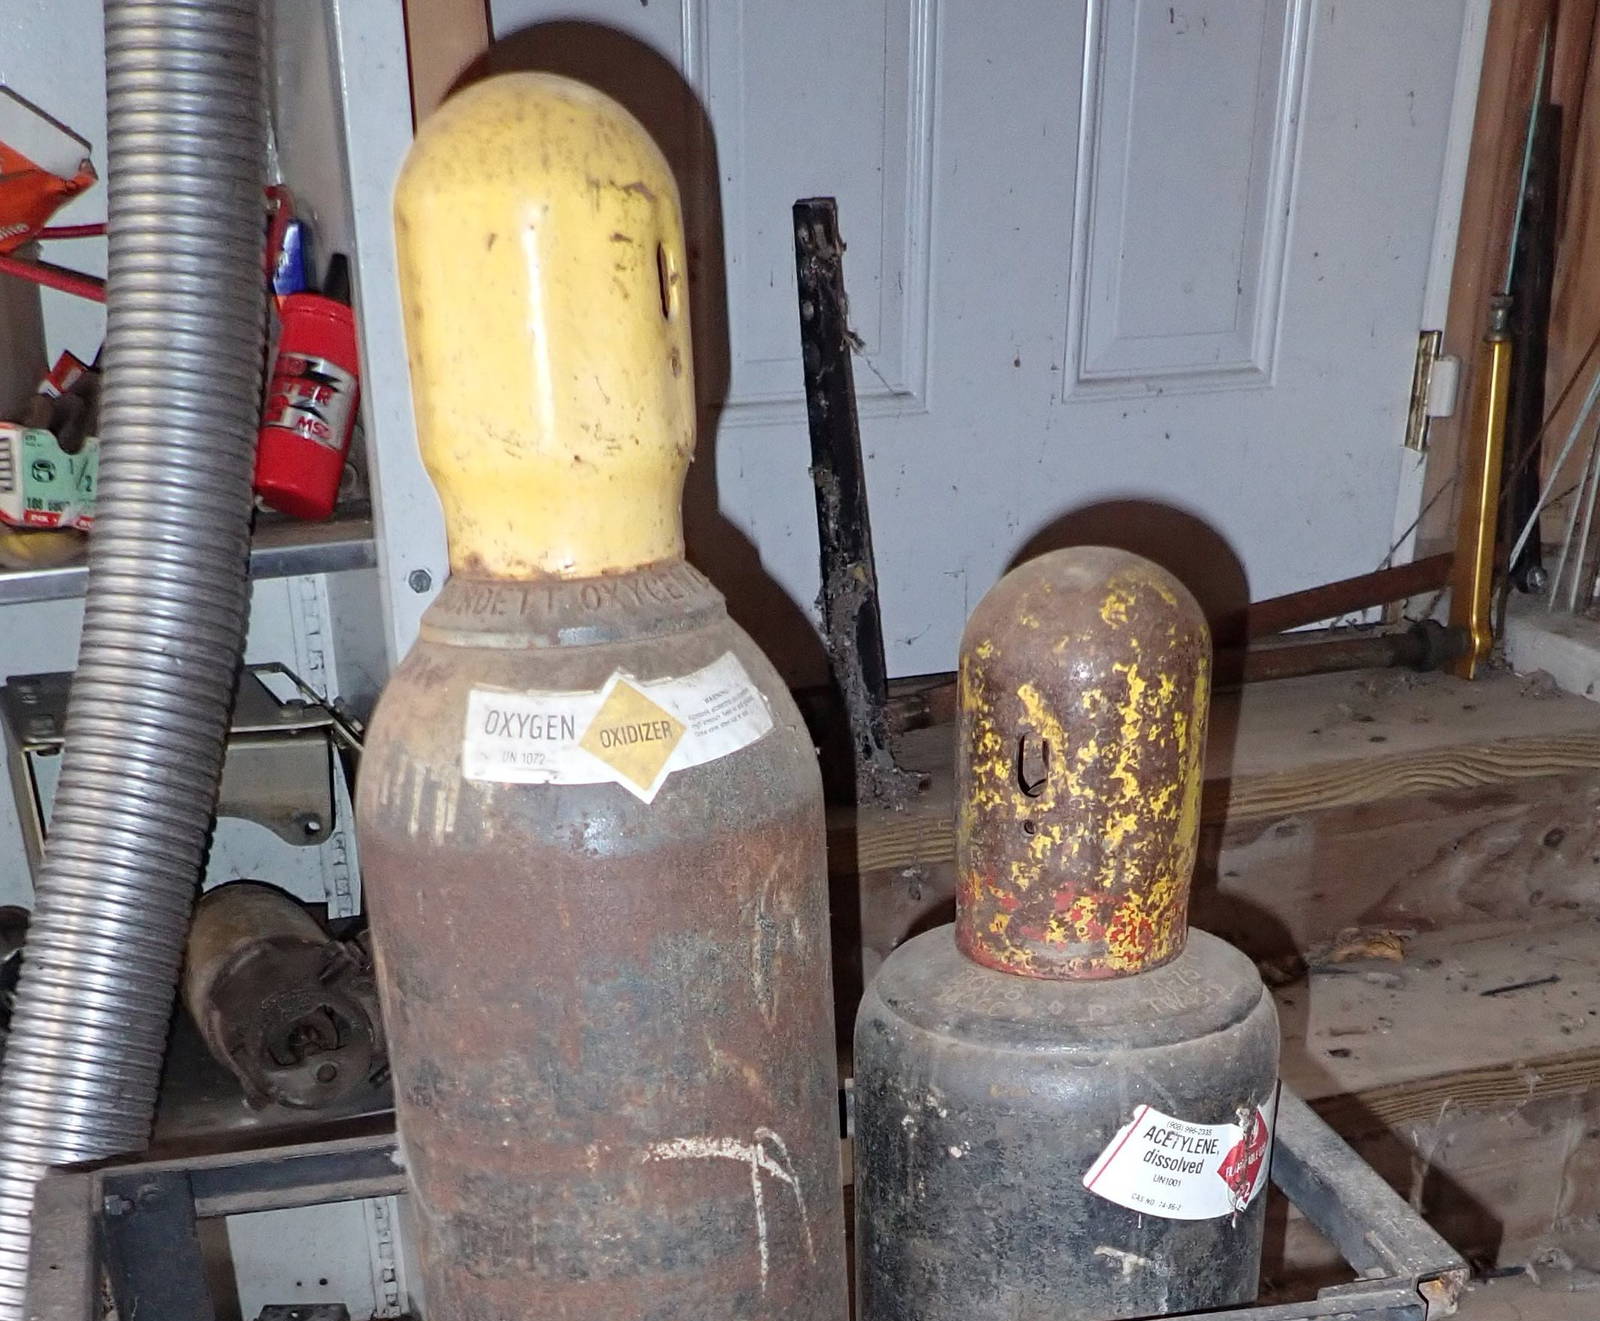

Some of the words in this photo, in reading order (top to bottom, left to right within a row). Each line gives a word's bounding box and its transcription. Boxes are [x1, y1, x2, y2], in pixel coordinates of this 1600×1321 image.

[484, 709, 576, 741] OXYGEN
[599, 720, 674, 749] OXIDIZER
[502, 751, 517, 763] UN
[522, 752, 546, 765] 1072
[1143, 1148, 1205, 1174] dissolved
[1153, 1174, 1182, 1187] UN1001
